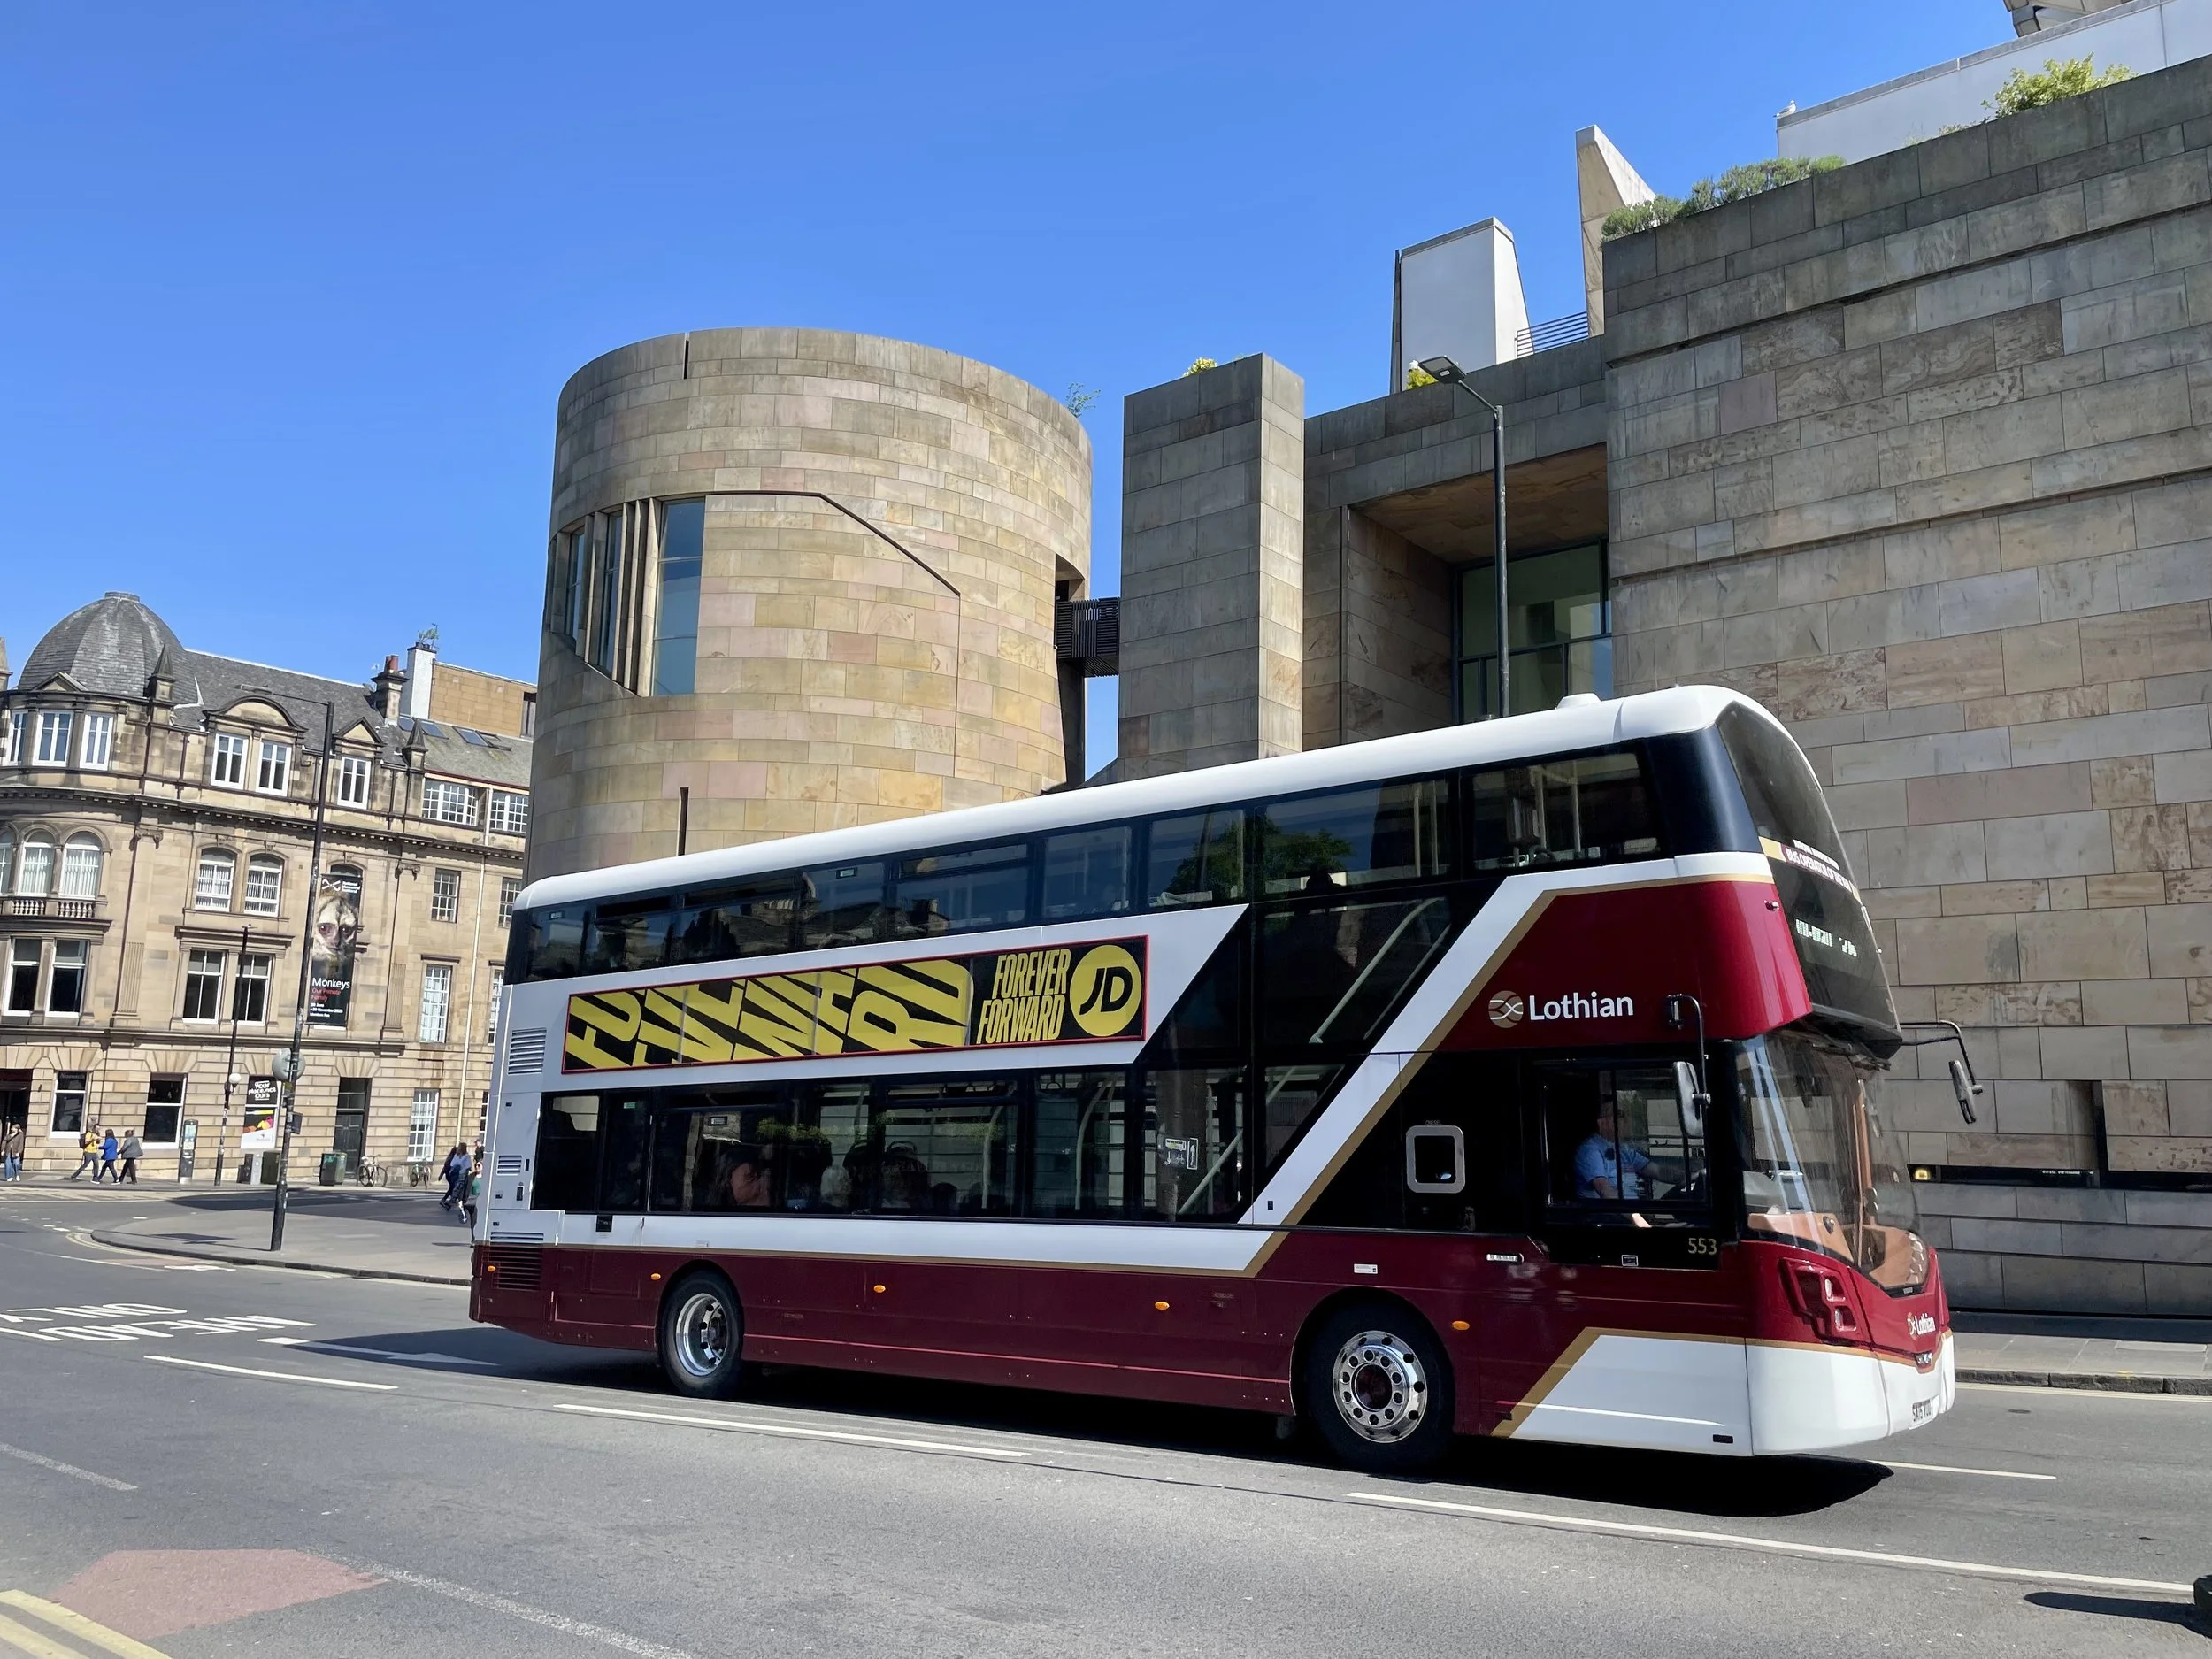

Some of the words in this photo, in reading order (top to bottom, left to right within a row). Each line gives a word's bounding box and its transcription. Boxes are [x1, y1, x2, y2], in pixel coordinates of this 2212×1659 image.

[311, 977, 350, 990] Monkeys
[992, 949, 1071, 999] FOREVER
[1079, 966, 1133, 1015] JD
[976, 994, 1065, 1044] FORWARD
[1529, 991, 1633, 1020] Lothian
[1688, 1237, 1717, 1255] 553
[0, 1303, 188, 1324] ONLY
[39, 1315, 317, 1341] AHEAD
